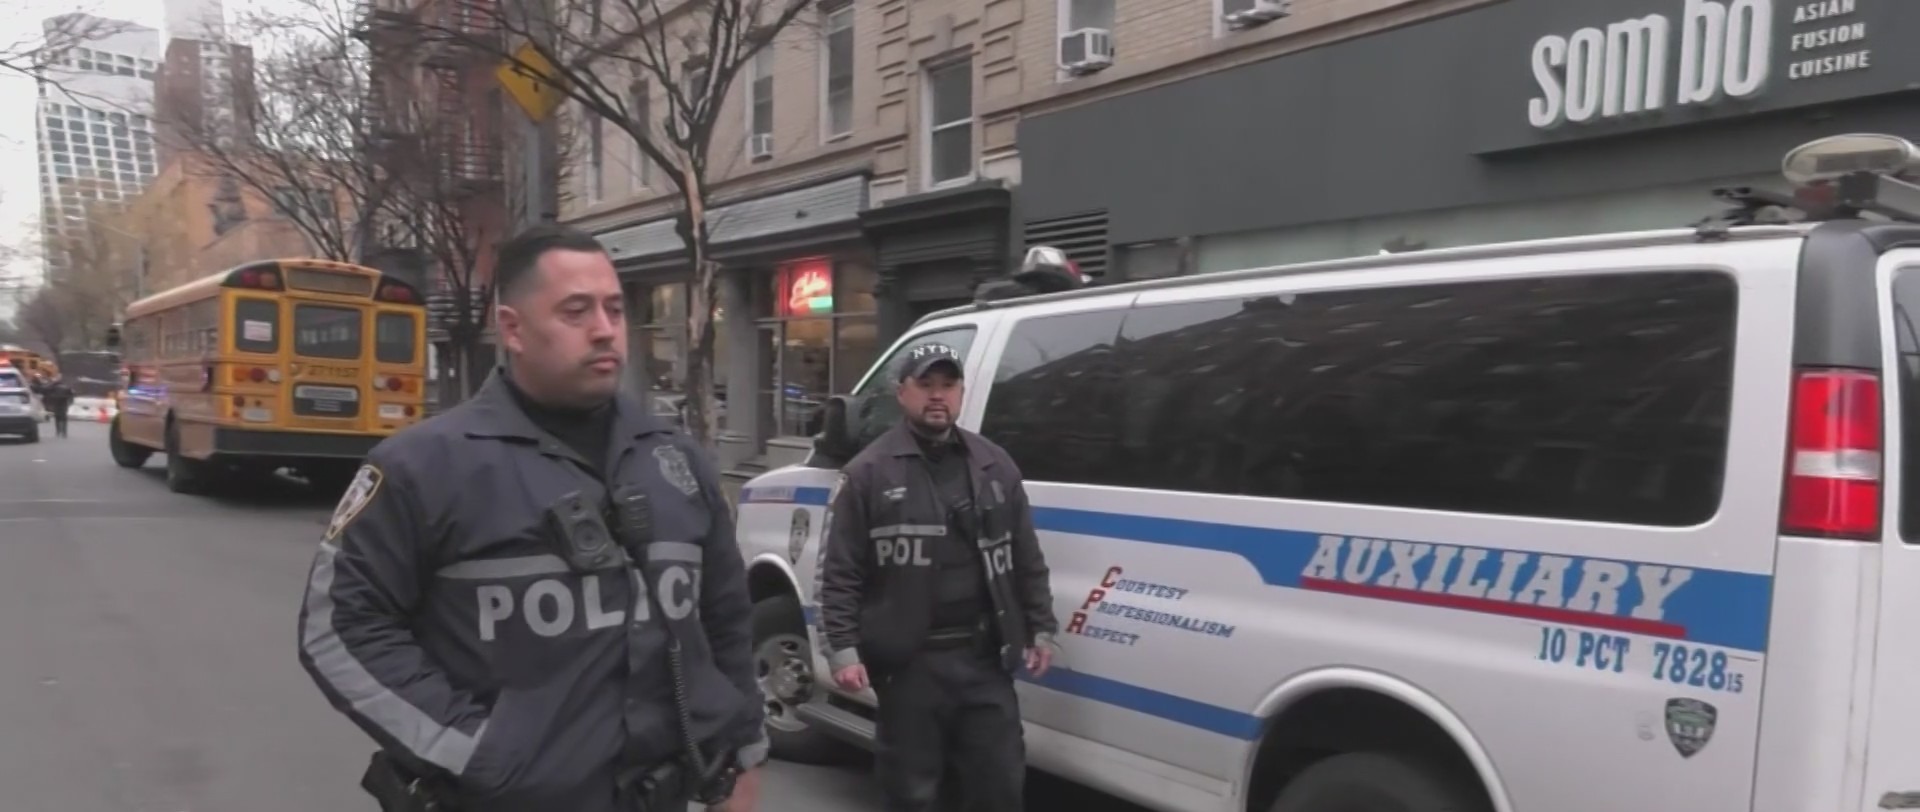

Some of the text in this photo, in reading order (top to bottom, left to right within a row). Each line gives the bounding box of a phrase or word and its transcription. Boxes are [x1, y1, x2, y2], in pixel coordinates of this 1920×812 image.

[1793, 0, 1856, 23] ASIAN
[1791, 22, 1865, 51] FUSION
[1789, 49, 1871, 79] CUISINE
[914, 345, 958, 359] NYPD
[1301, 533, 1693, 622] AUXILIARY
[476, 566, 701, 641] POLIC
[1539, 627, 1567, 663] 10
[1576, 631, 1630, 673] PCT
[1653, 641, 1728, 691] 7828
